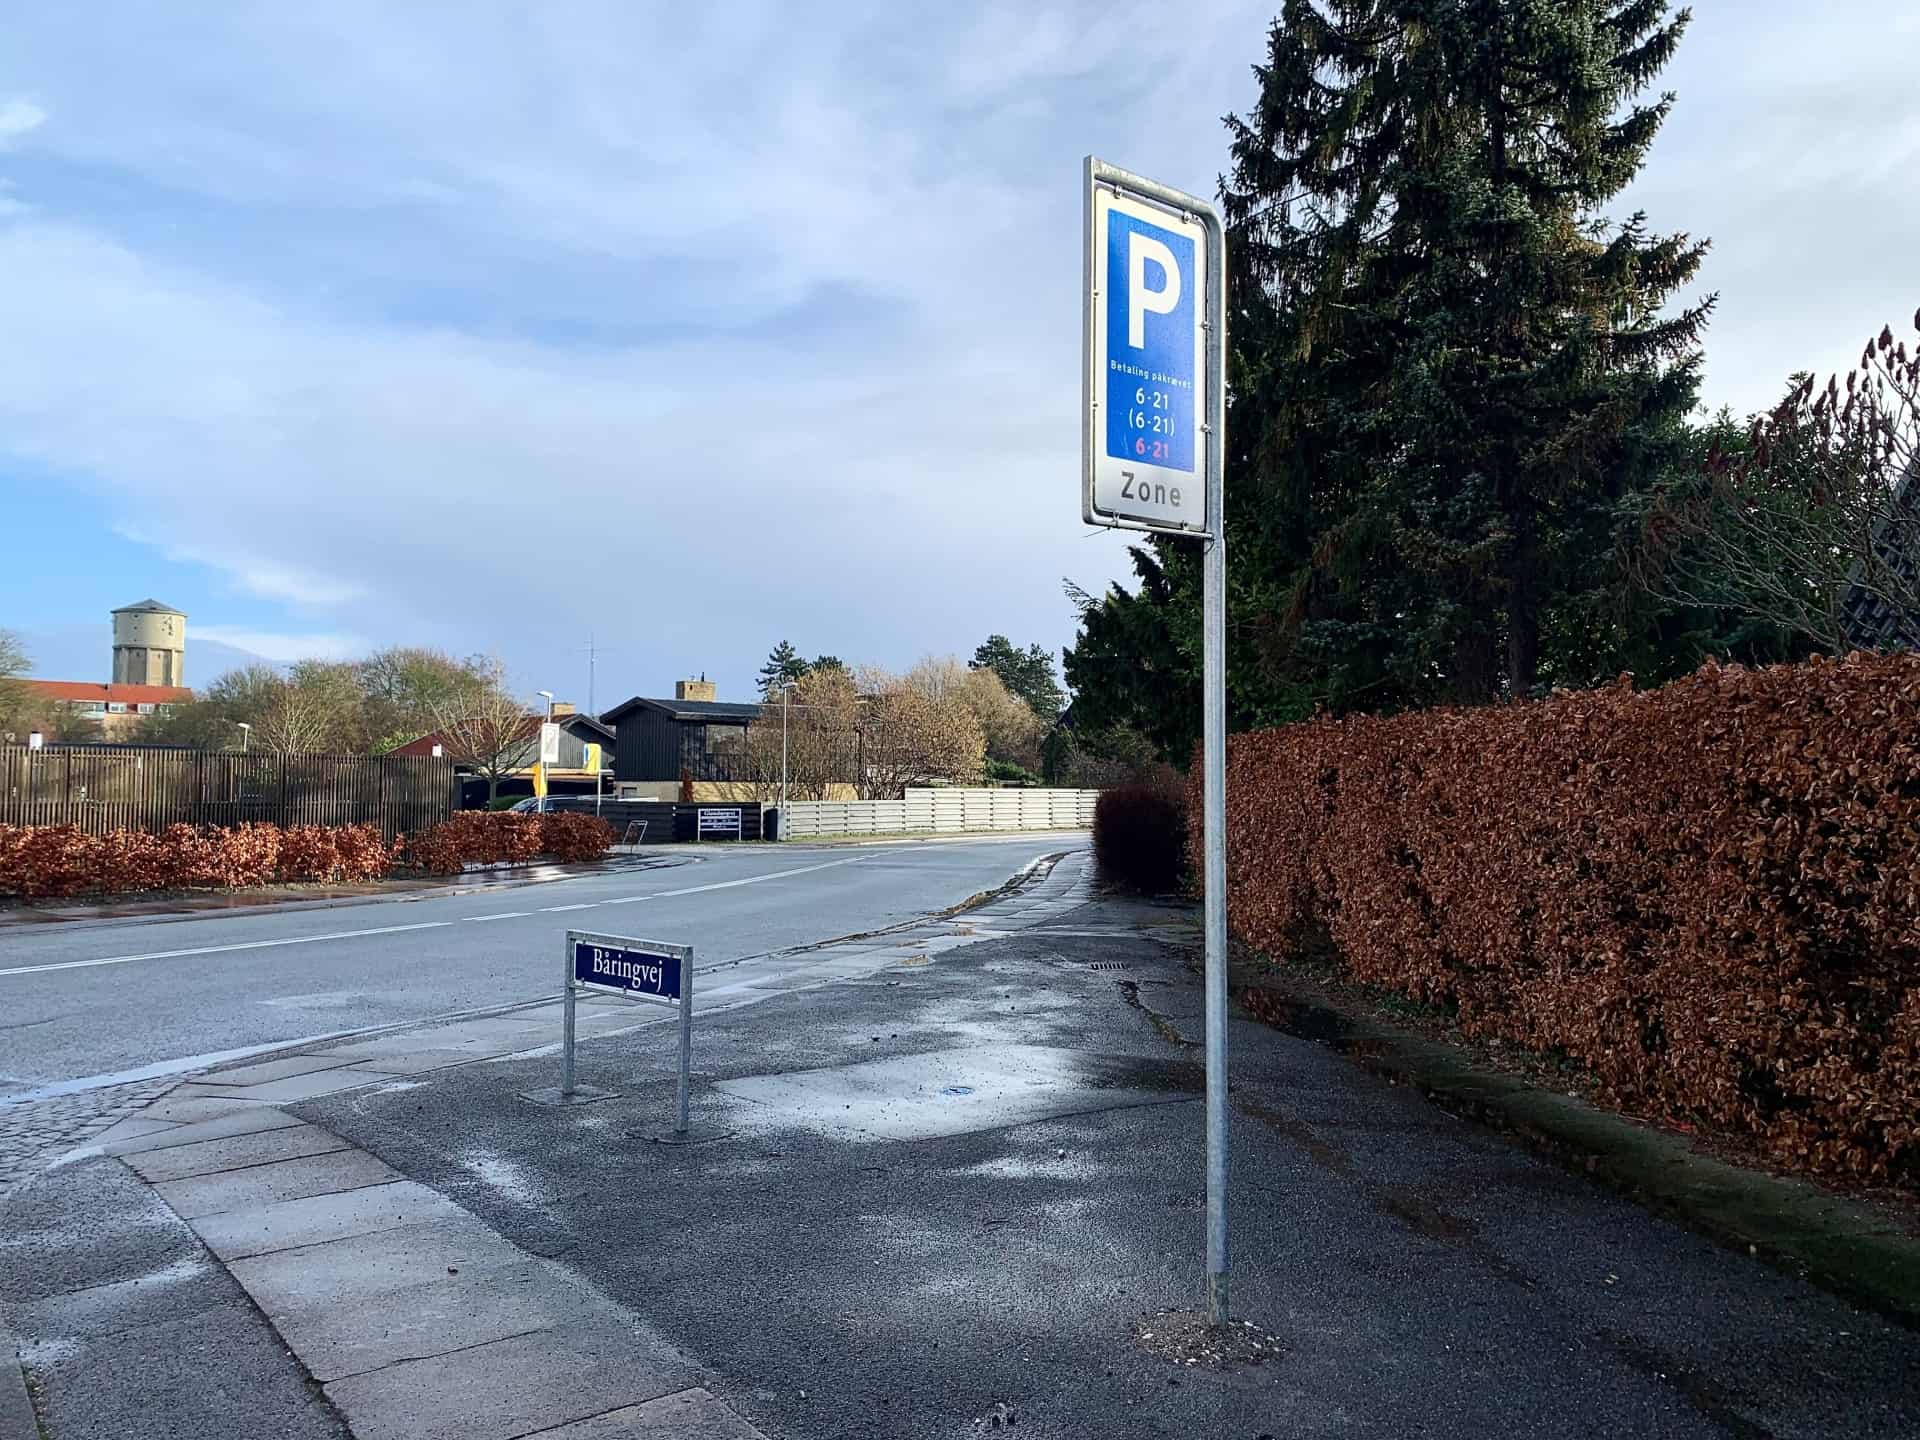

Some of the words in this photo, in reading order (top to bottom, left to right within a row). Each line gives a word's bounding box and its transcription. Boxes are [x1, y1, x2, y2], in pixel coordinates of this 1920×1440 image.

[1128, 230, 1181, 349] P
[1110, 359, 1149, 380] Betaling
[1151, 371, 1192, 389] påkrævet
[1121, 471, 1181, 507] Zone
[592, 947, 663, 993] Båringvej
